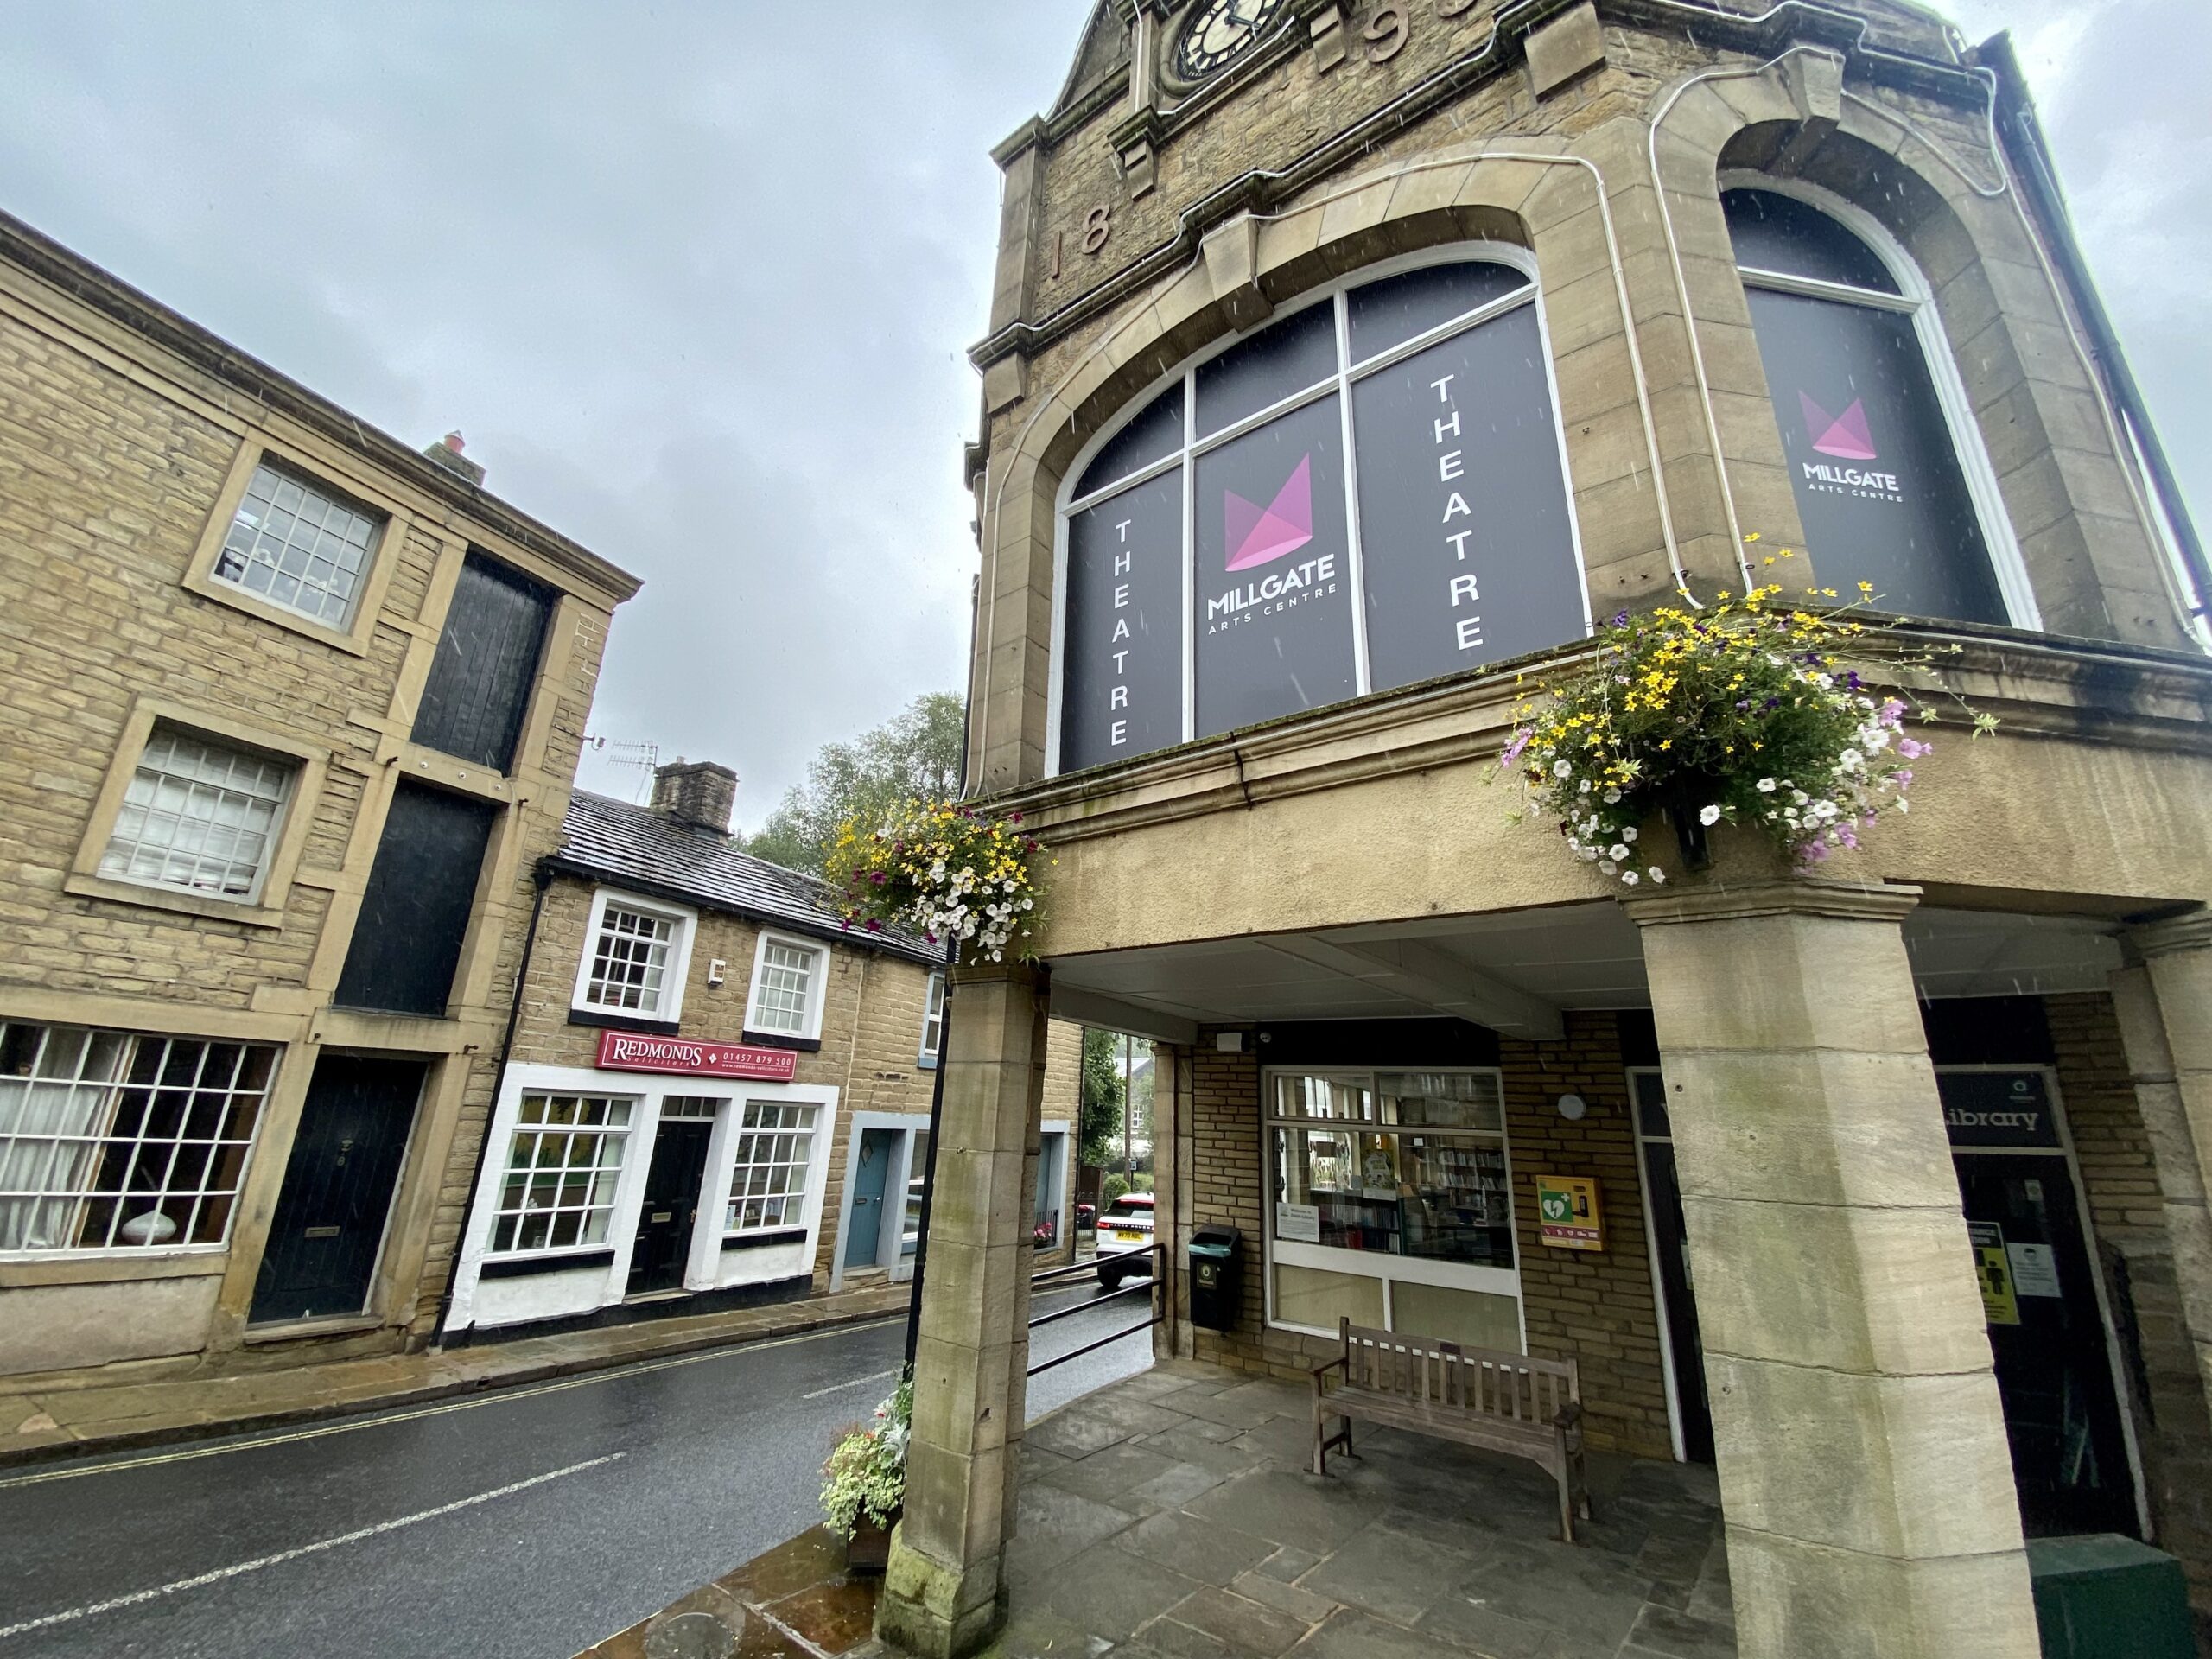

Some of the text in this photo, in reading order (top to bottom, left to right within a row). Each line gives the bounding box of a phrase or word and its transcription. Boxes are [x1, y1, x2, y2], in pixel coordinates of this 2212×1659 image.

[1051, 203, 1110, 278] 18
[1802, 462, 1900, 492] MILLGATE
[1808, 483, 1904, 503] ARTS CENTRE
[1430, 373, 1484, 651] THEATRE
[1207, 553, 1336, 620] MILLGATE
[1208, 583, 1337, 635] ARTS CENTRE
[1110, 518, 1132, 747] THEATRE
[612, 1038, 702, 1066] REDMONDS
[722, 1052, 791, 1066] 01457 879 500
[1945, 1108, 2039, 1131] ibrary
